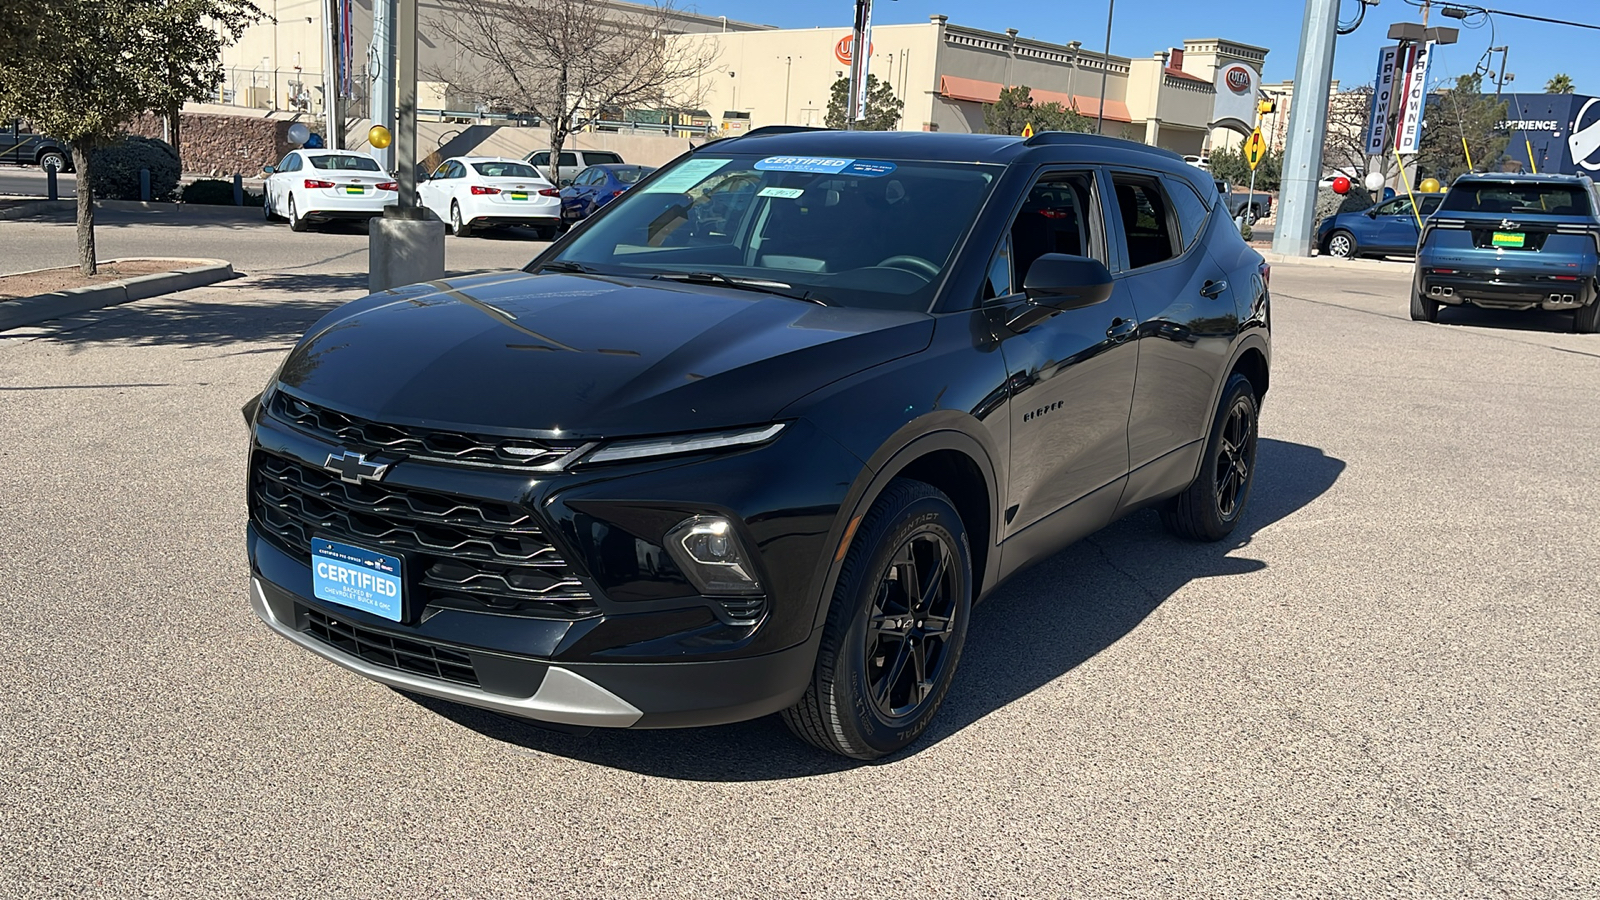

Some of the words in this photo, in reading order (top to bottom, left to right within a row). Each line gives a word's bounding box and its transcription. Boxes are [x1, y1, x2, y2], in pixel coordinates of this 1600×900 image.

[1383, 52, 1395, 84] PRE
[1415, 50, 1427, 81] PRE
[1372, 91, 1390, 148] OWNED
[1403, 89, 1420, 147] OWNED
[764, 156, 846, 167] CERTIFIED
[1024, 400, 1064, 422] BLAZER
[317, 562, 397, 597] CERTIFIED
[342, 585, 364, 596] BACKED
[365, 591, 373, 599] BY
[324, 586, 356, 599] CHEVROLET
[357, 596, 374, 606] BUICK
[379, 602, 391, 611] GMC
